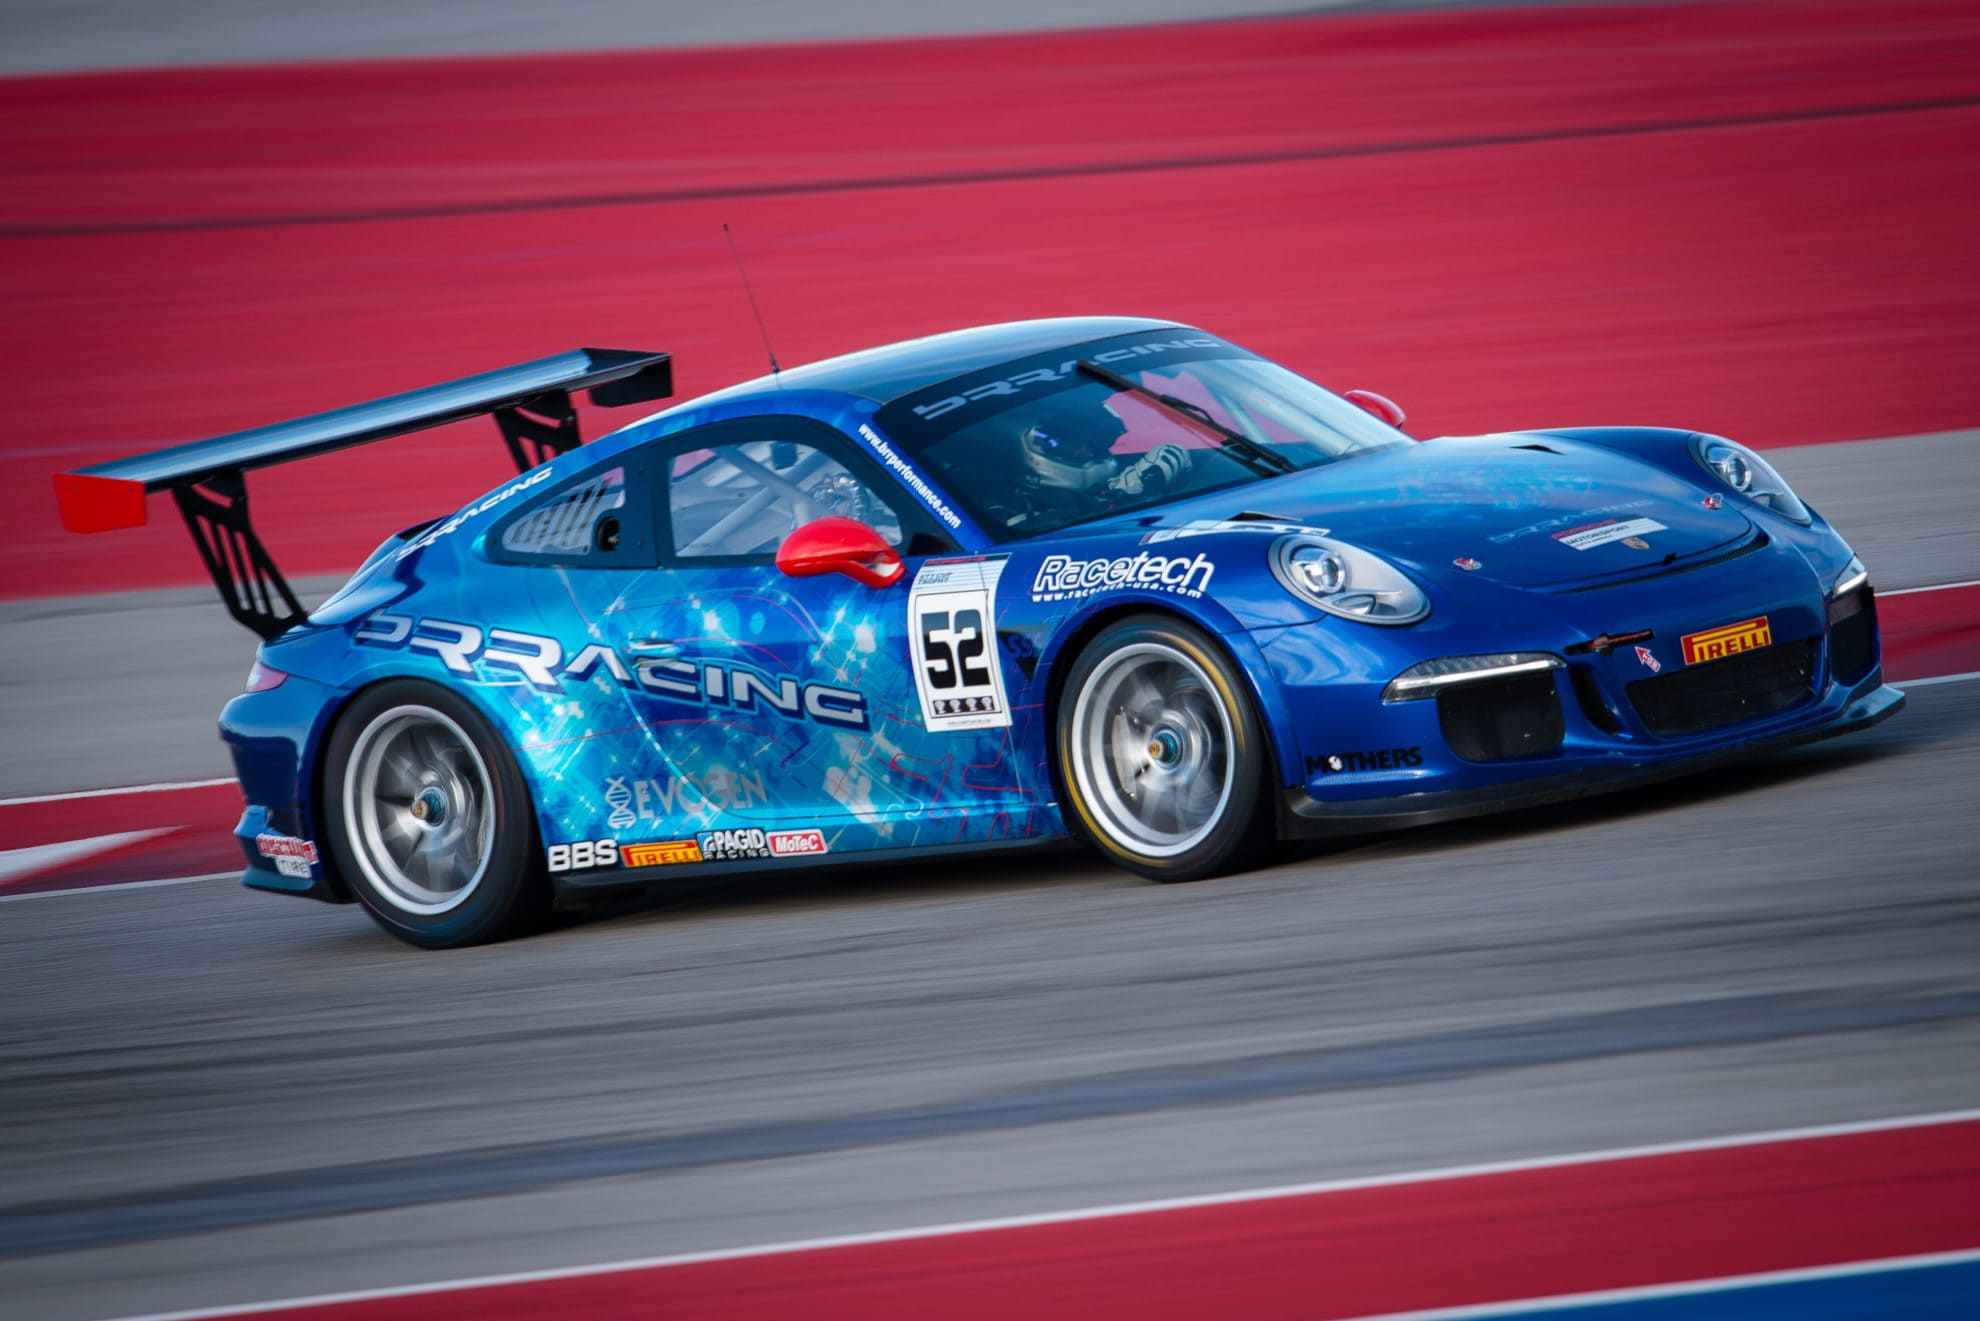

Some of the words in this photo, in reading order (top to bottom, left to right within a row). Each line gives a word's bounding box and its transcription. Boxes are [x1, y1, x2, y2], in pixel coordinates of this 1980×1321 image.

[858, 423, 961, 529] www.brrperformance.com
[1033, 550, 1215, 592] Racetech
[1031, 581, 1204, 603] www.racetech-usa.com
[921, 609, 991, 689] 52
[1681, 616, 1770, 665] PIRELLI
[1305, 746, 1424, 775] MOTHERS
[633, 770, 767, 819] EVOGEN
[620, 840, 703, 868] PIRELLI
[703, 848, 770, 860] RACING
[713, 829, 766, 851] PAGID
[775, 834, 820, 853] MoTeC
[548, 839, 618, 873] BBS
